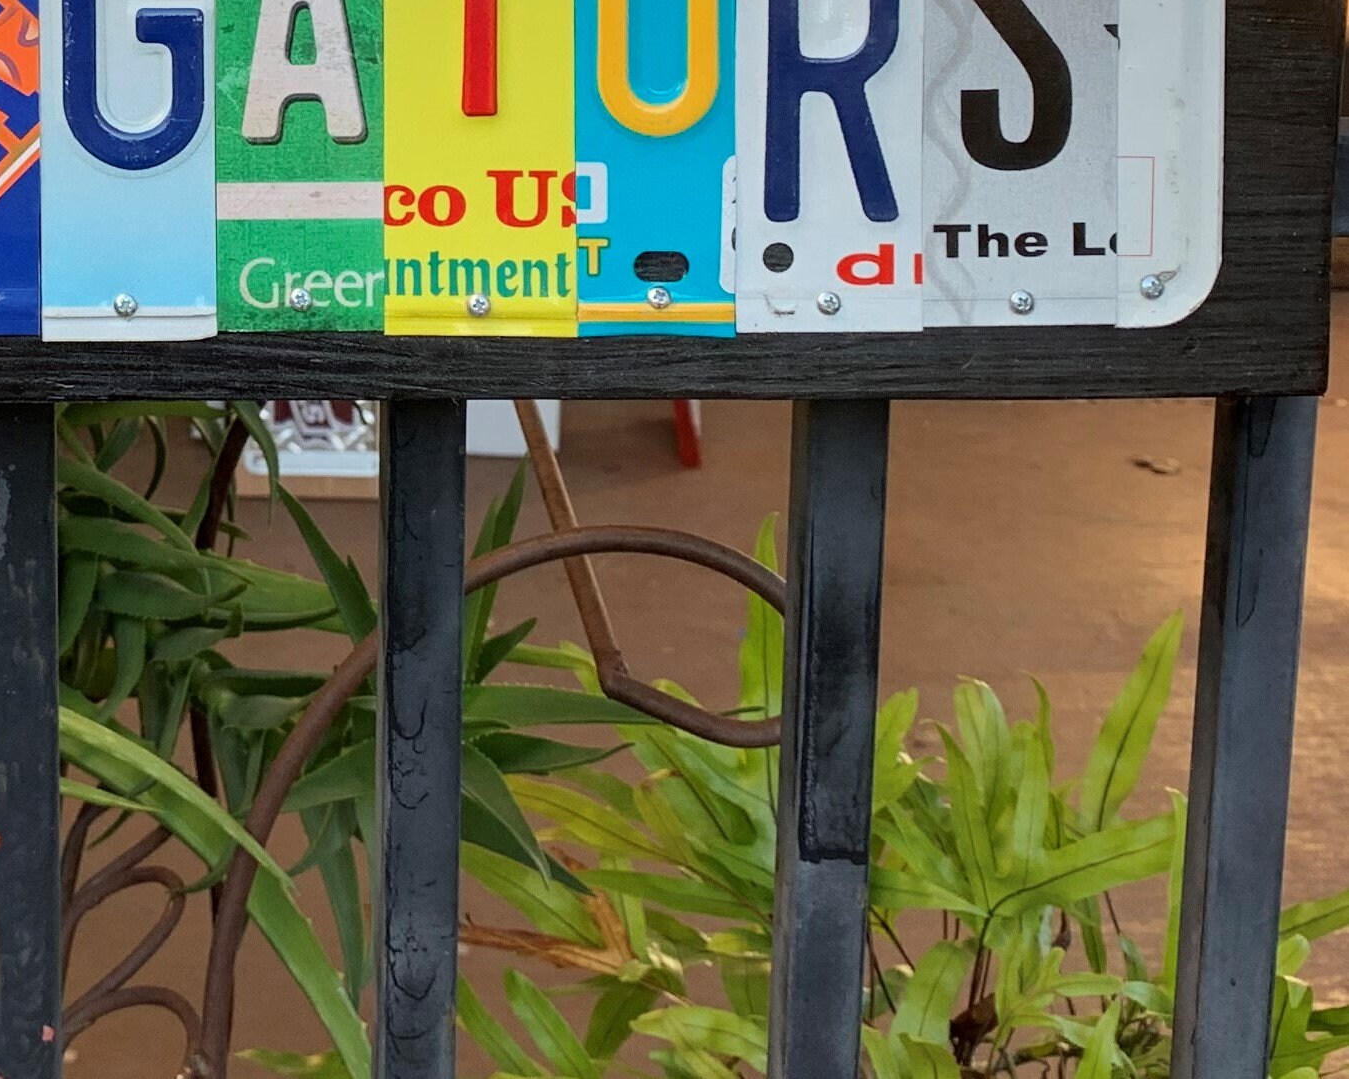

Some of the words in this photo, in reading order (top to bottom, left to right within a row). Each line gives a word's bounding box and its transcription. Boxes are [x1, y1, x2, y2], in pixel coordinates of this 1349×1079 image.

[384, 184, 467, 227] co
[933, 223, 1049, 258] The
[384, 250, 572, 298] ntment
